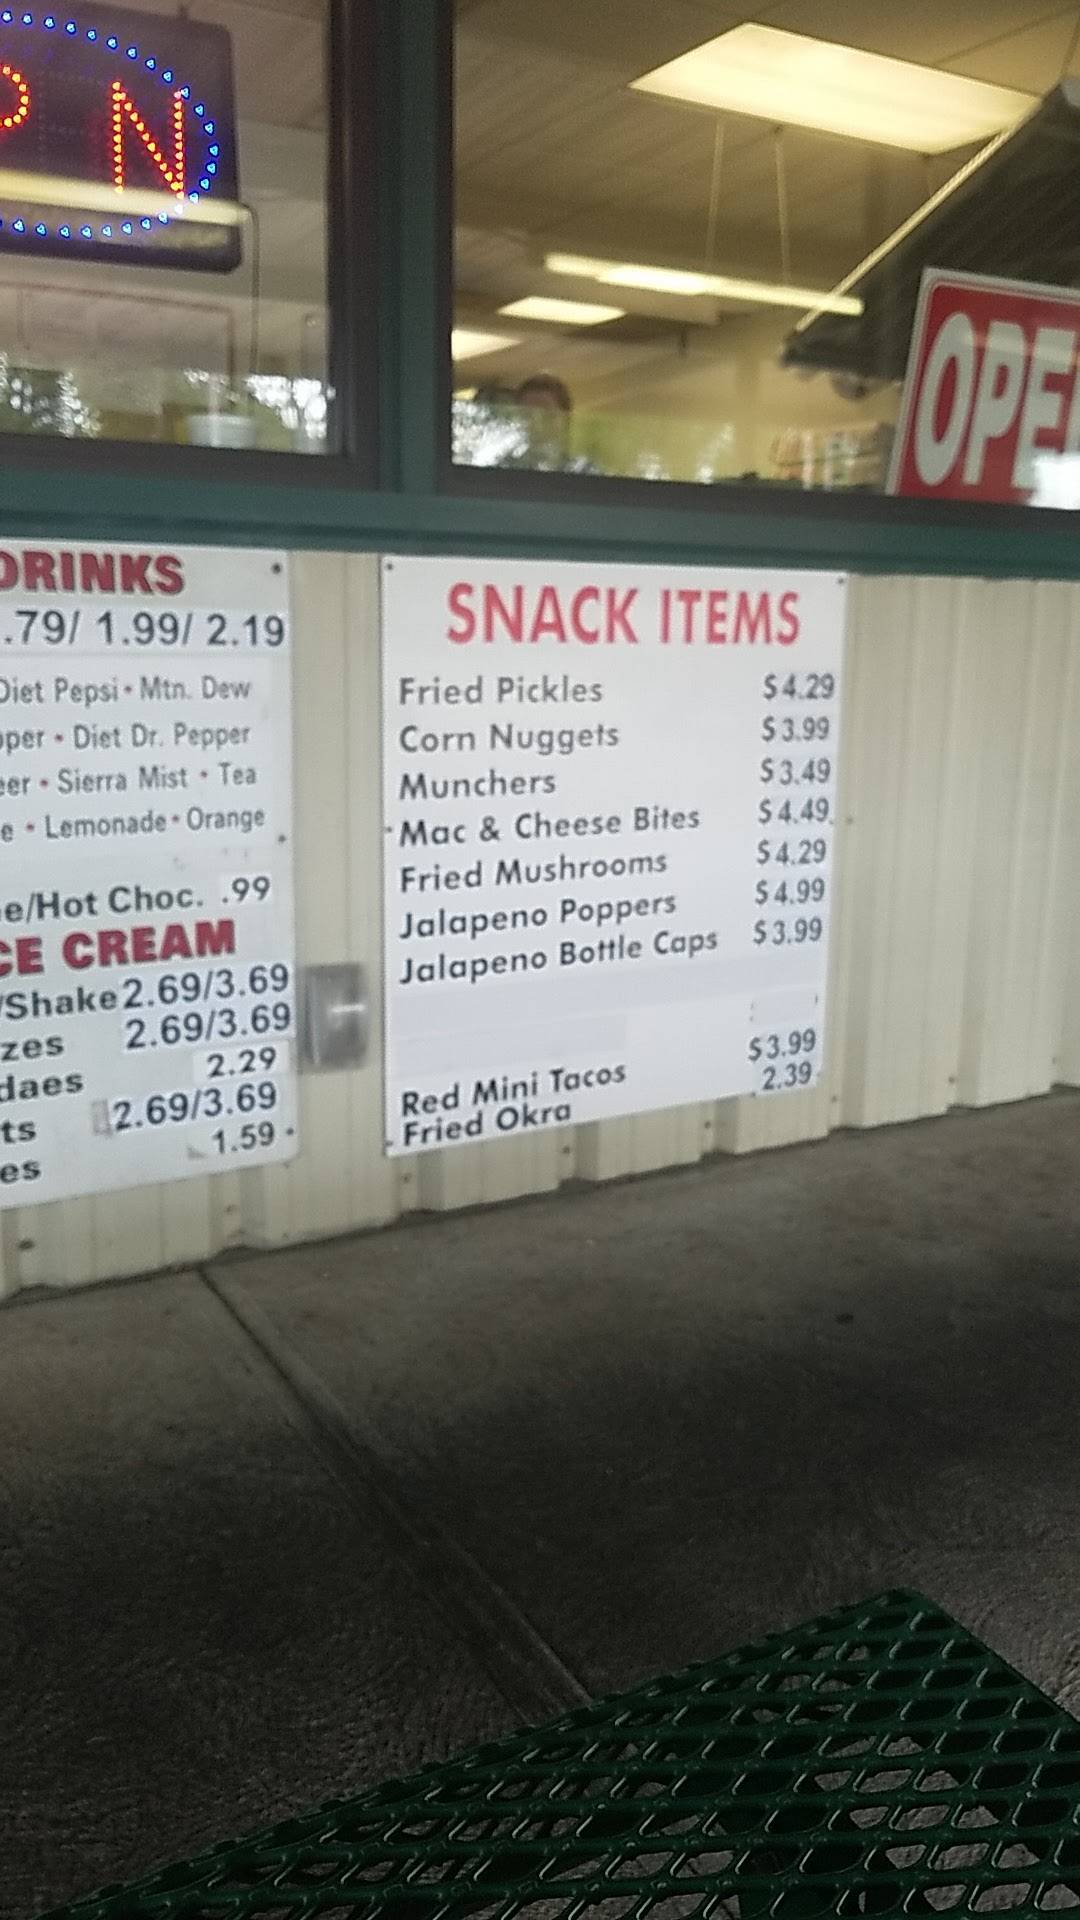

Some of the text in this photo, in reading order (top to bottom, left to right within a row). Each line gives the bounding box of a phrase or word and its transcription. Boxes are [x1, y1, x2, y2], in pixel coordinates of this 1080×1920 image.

[915, 312, 1080, 490] OPE
[0, 550, 184, 594] DRINKS
[96, 610, 193, 646] 1.99/
[206, 612, 285, 647] 2.19
[446, 582, 800, 645] SNACK ITEMS
[0, 675, 250, 709] Diet Pepsi Mtn. Dew
[399, 675, 603, 706] Fried Pickles
[763, 673, 836, 700] $4.29
[0, 722, 250, 756] per Diet Dr. Pepper
[399, 724, 620, 757] Corn Nuggets
[762, 716, 830, 742] $3.99
[57, 767, 127, 795] Sierra
[139, 764, 187, 788] Mist
[219, 762, 257, 785] Tea
[399, 768, 556, 800] Munchers
[760, 758, 830, 787] $3.49
[45, 810, 167, 840] Lemonade
[187, 806, 265, 833] Orange
[399, 806, 701, 848] Mac & Cheese Bites
[757, 840, 827, 867] $4.29
[399, 852, 668, 893] Fried Mushrooms
[0, 876, 271, 924] e/Hot Choc. .99
[755, 878, 826, 905] $4.99
[399, 895, 677, 940] Jalapeno Poppers
[753, 917, 823, 946] $3.99
[62, 919, 236, 970] CREAM
[399, 929, 719, 984] Jalapeno Bottle Caps
[122, 963, 290, 1010] 2.69/3.69
[125, 1002, 291, 1049] 2.69/3.69
[748, 1028, 816, 1061] $3.99
[206, 1047, 277, 1078] 2.29
[762, 1061, 812, 1090] 2.39
[113, 1081, 277, 1131] 2.69/3.69
[402, 1064, 626, 1116] Red Mini Tacos
[212, 1121, 275, 1154] 1.59
[403, 1102, 571, 1147] Fried Okra
